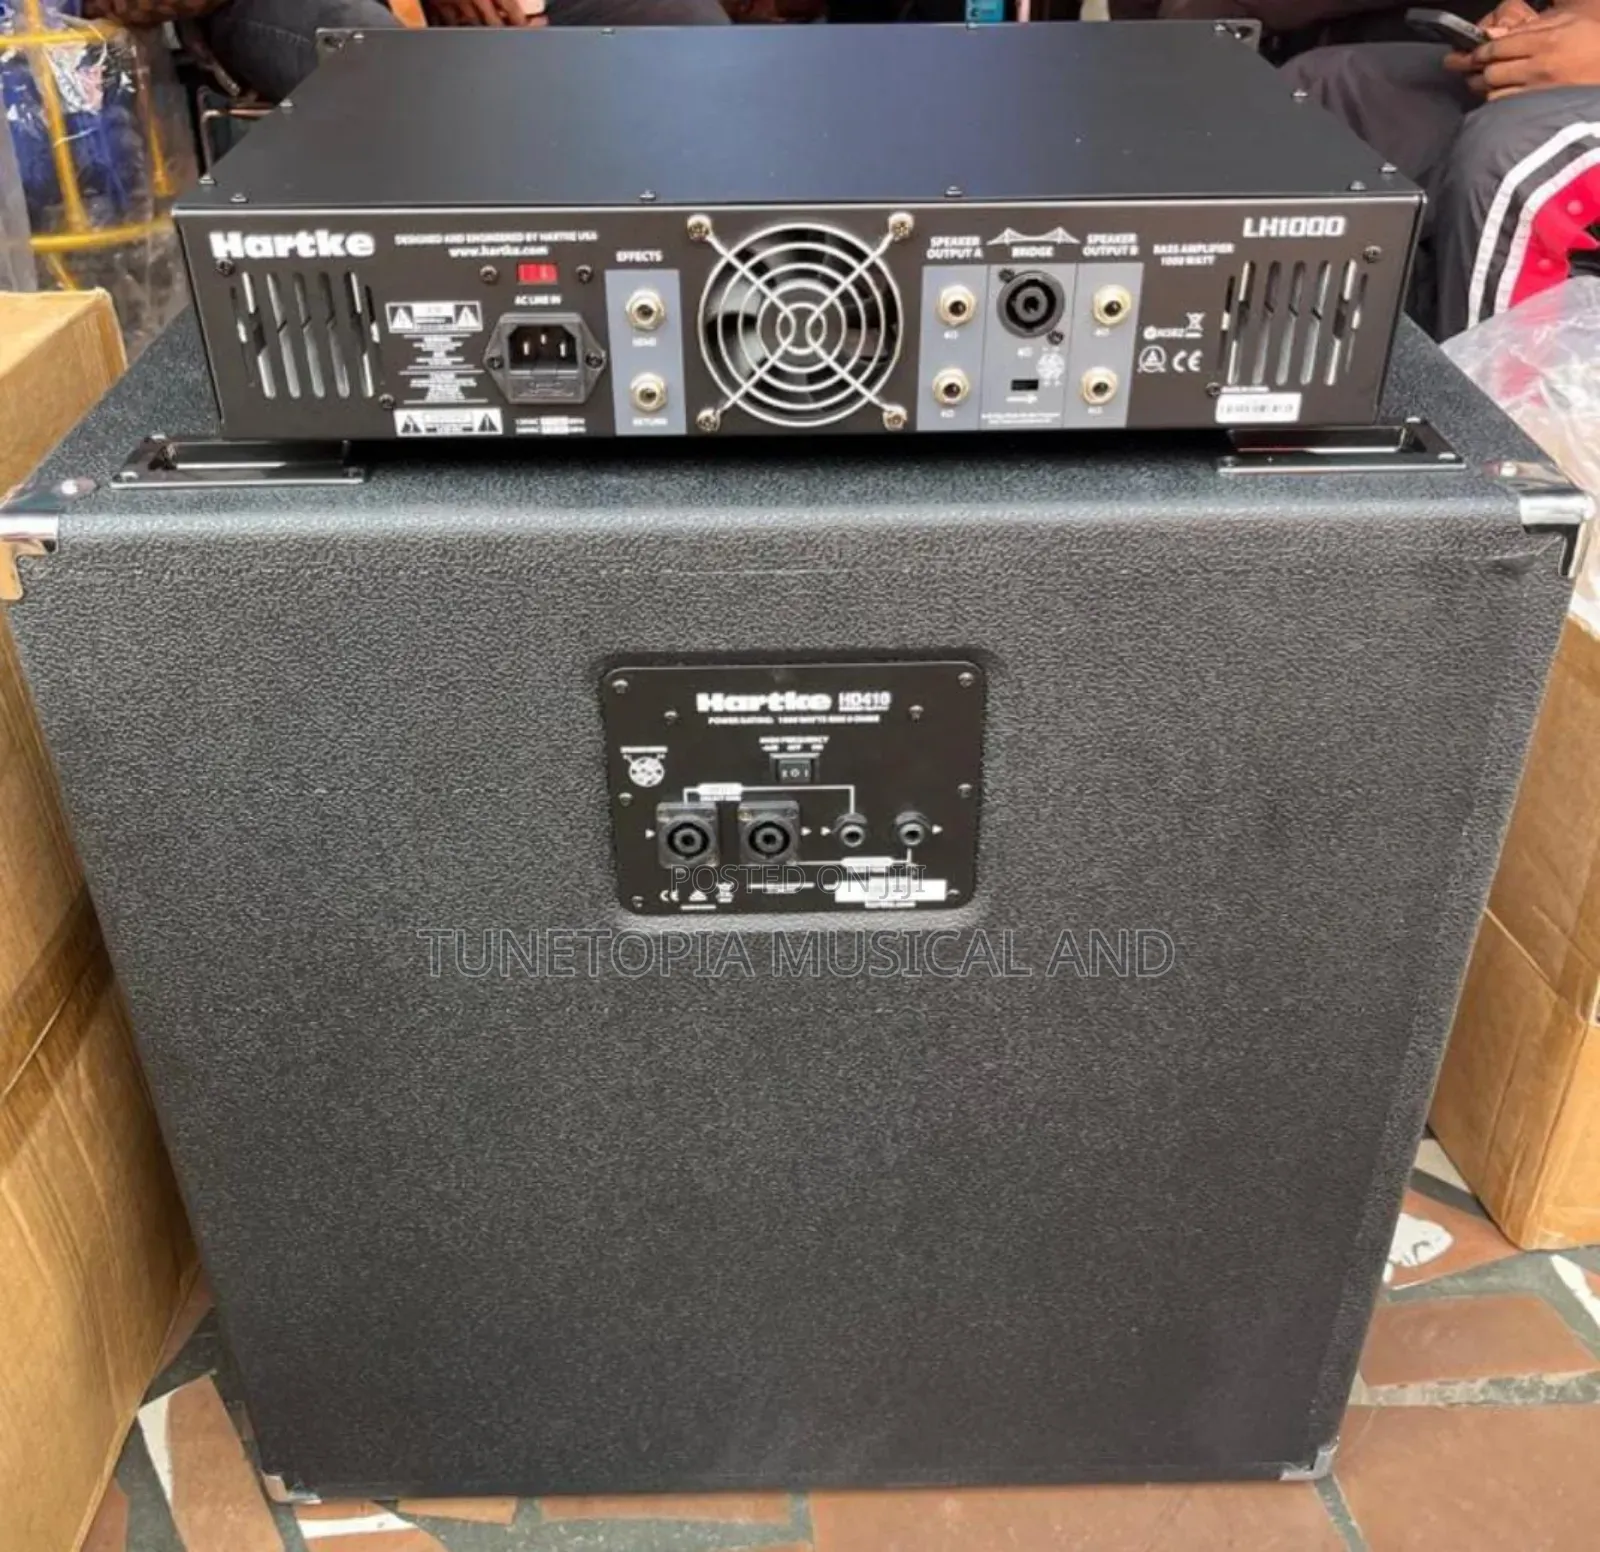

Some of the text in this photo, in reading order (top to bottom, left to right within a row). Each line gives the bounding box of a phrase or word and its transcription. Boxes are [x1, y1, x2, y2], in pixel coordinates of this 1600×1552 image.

[1242, 216, 1347, 238] LH1000
[208, 229, 376, 258] Hartke
[929, 236, 981, 247] SPEAKER
[1086, 233, 1138, 244] SPEAKER
[615, 250, 664, 263] EFFECTS
[926, 248, 983, 259] OUTPUT A
[1011, 246, 1054, 258] BRIDGE
[1082, 245, 1139, 256] OUTPUT B
[696, 691, 832, 712] Hartke
